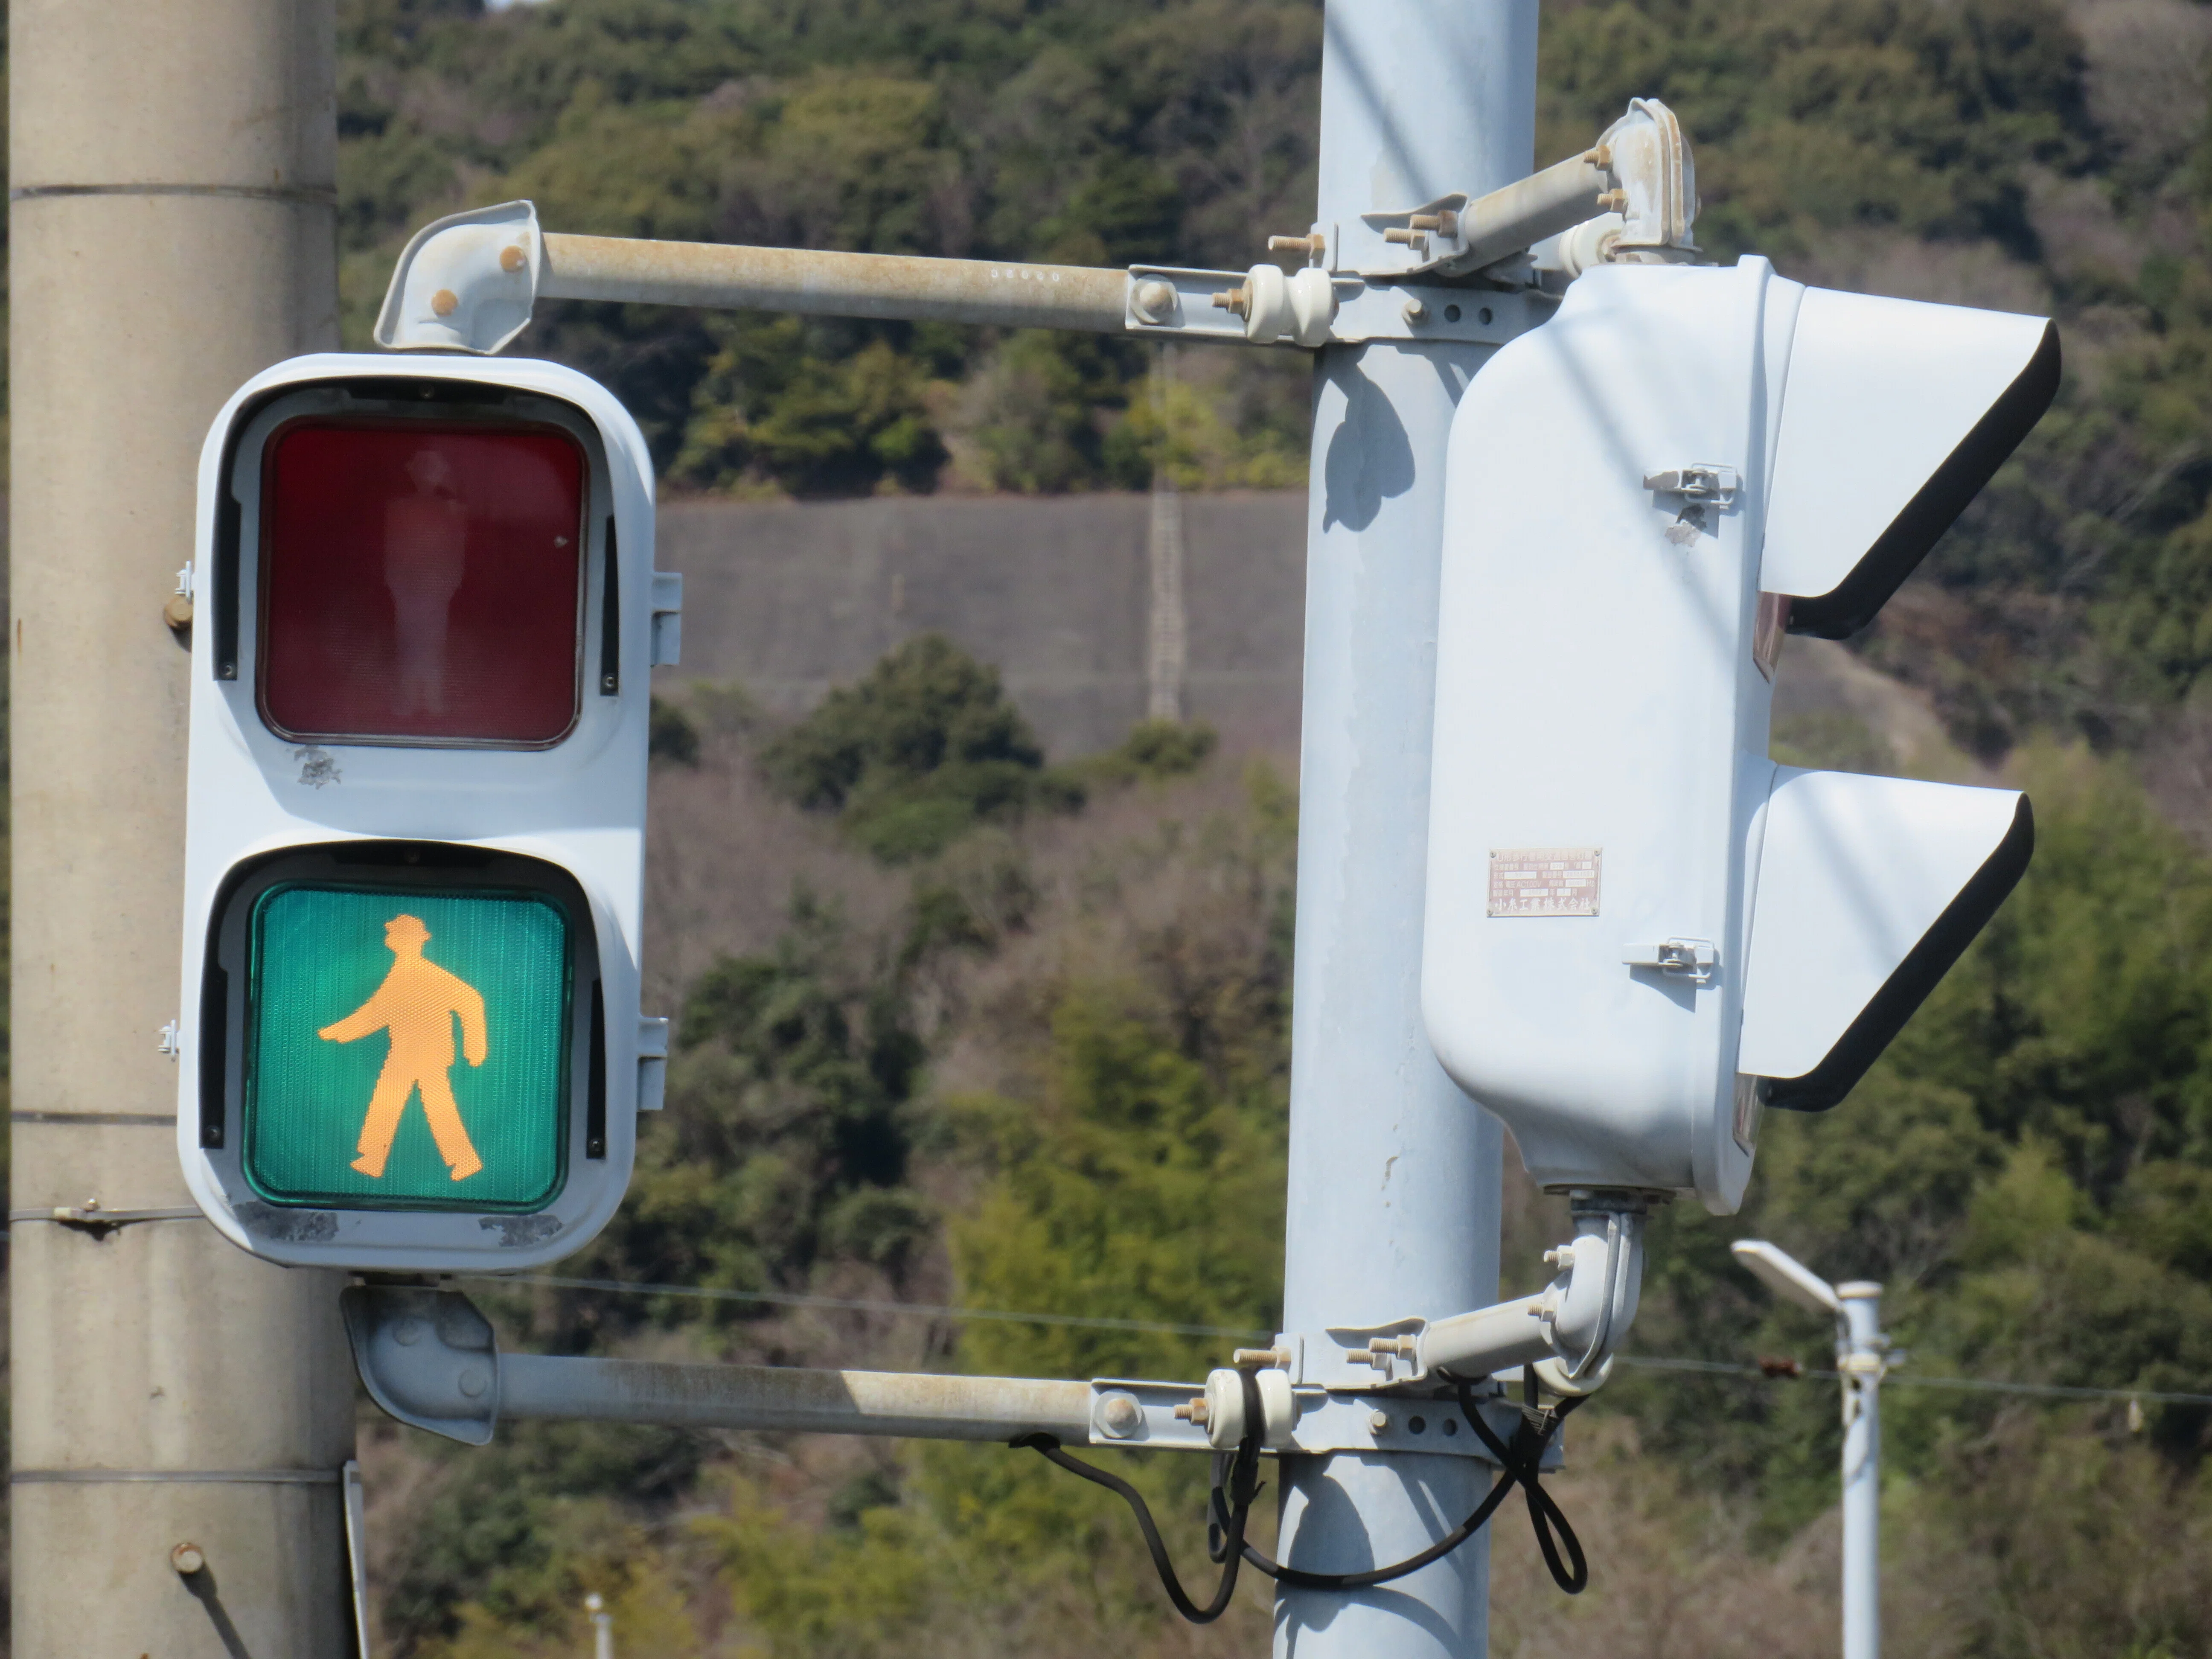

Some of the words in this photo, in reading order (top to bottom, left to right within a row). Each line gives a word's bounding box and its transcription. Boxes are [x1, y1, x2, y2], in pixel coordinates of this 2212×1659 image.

[1494, 897, 1591, 911] 小糸工業株式会社
